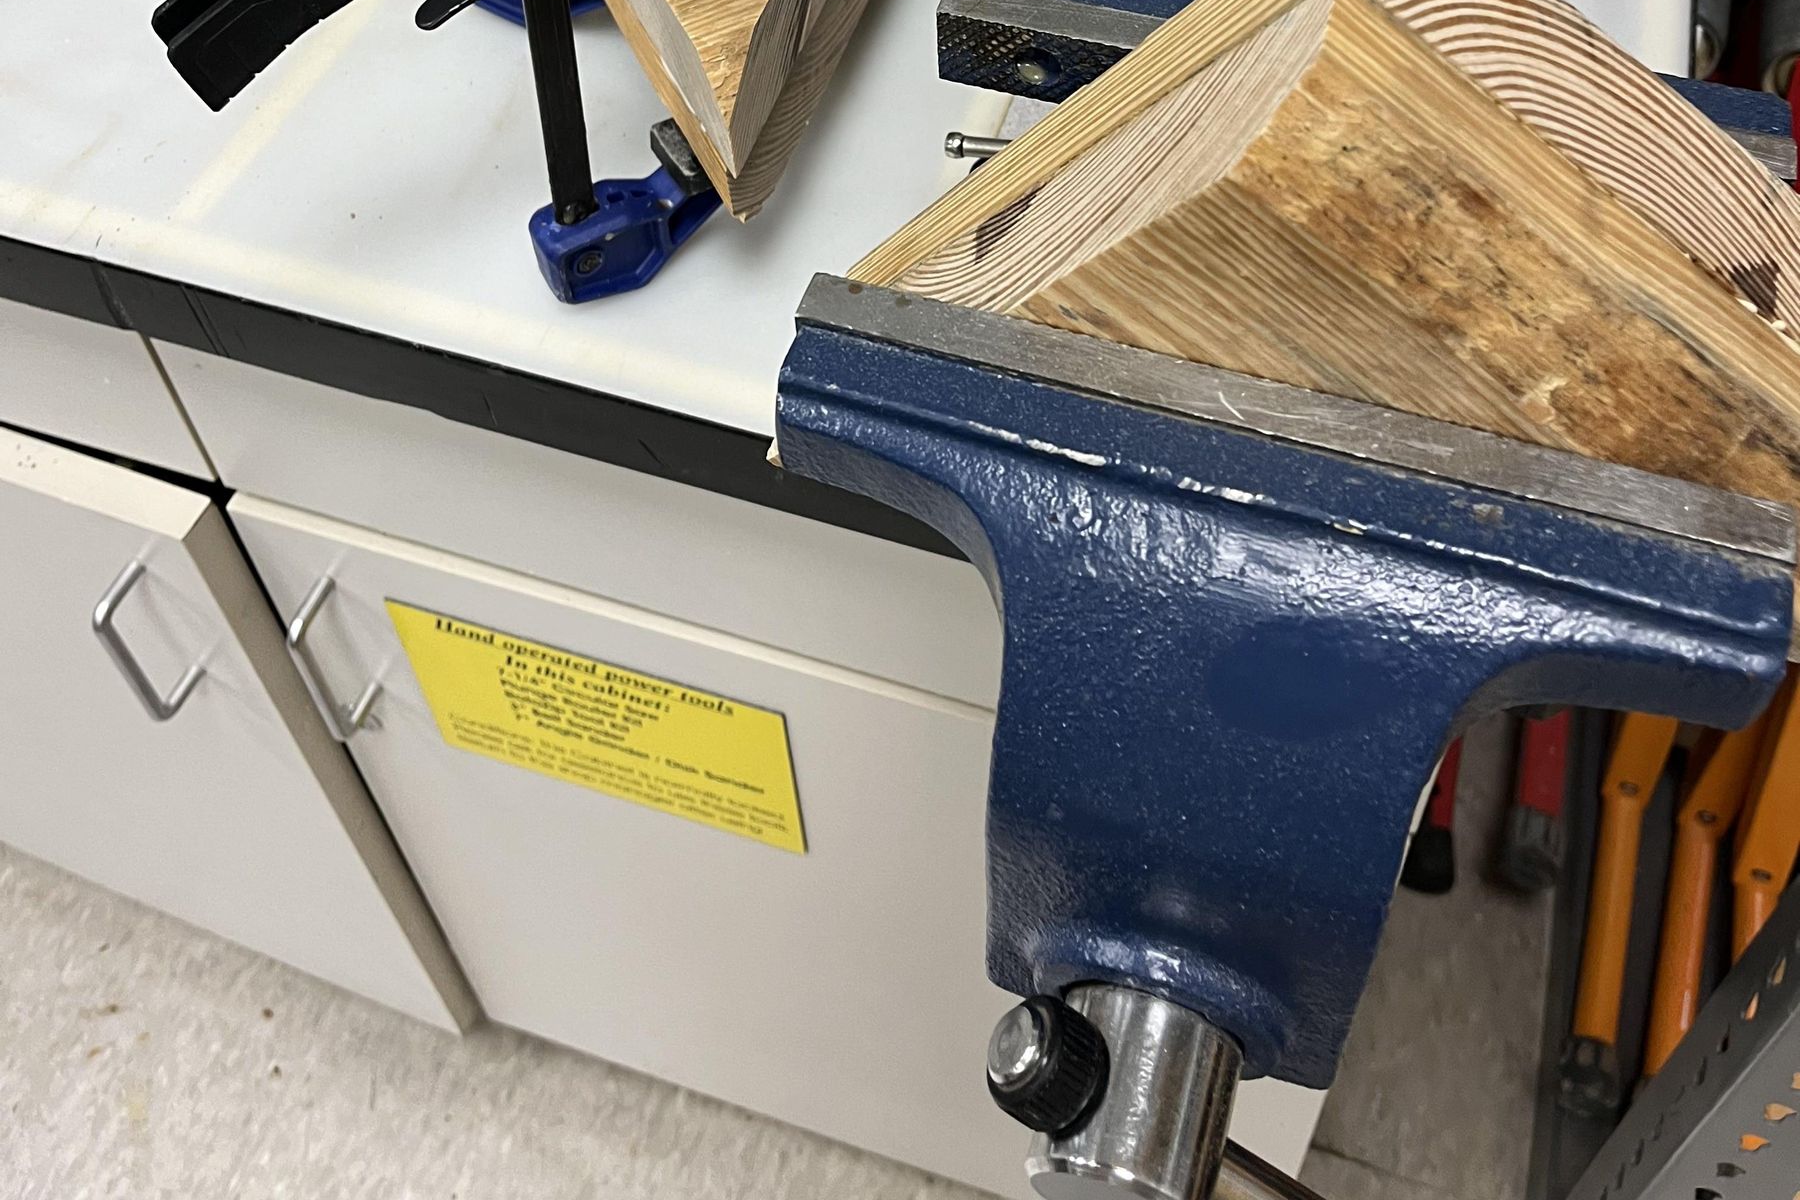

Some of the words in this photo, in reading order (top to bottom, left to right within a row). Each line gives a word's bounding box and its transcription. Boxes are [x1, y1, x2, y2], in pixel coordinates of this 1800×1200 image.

[436, 618, 495, 646] Hand
[502, 641, 597, 675] operated
[605, 671, 673, 697] power
[680, 692, 734, 717] tools
[506, 655, 528, 671] In
[536, 665, 575, 685] this
[582, 680, 670, 714] cabinet:
